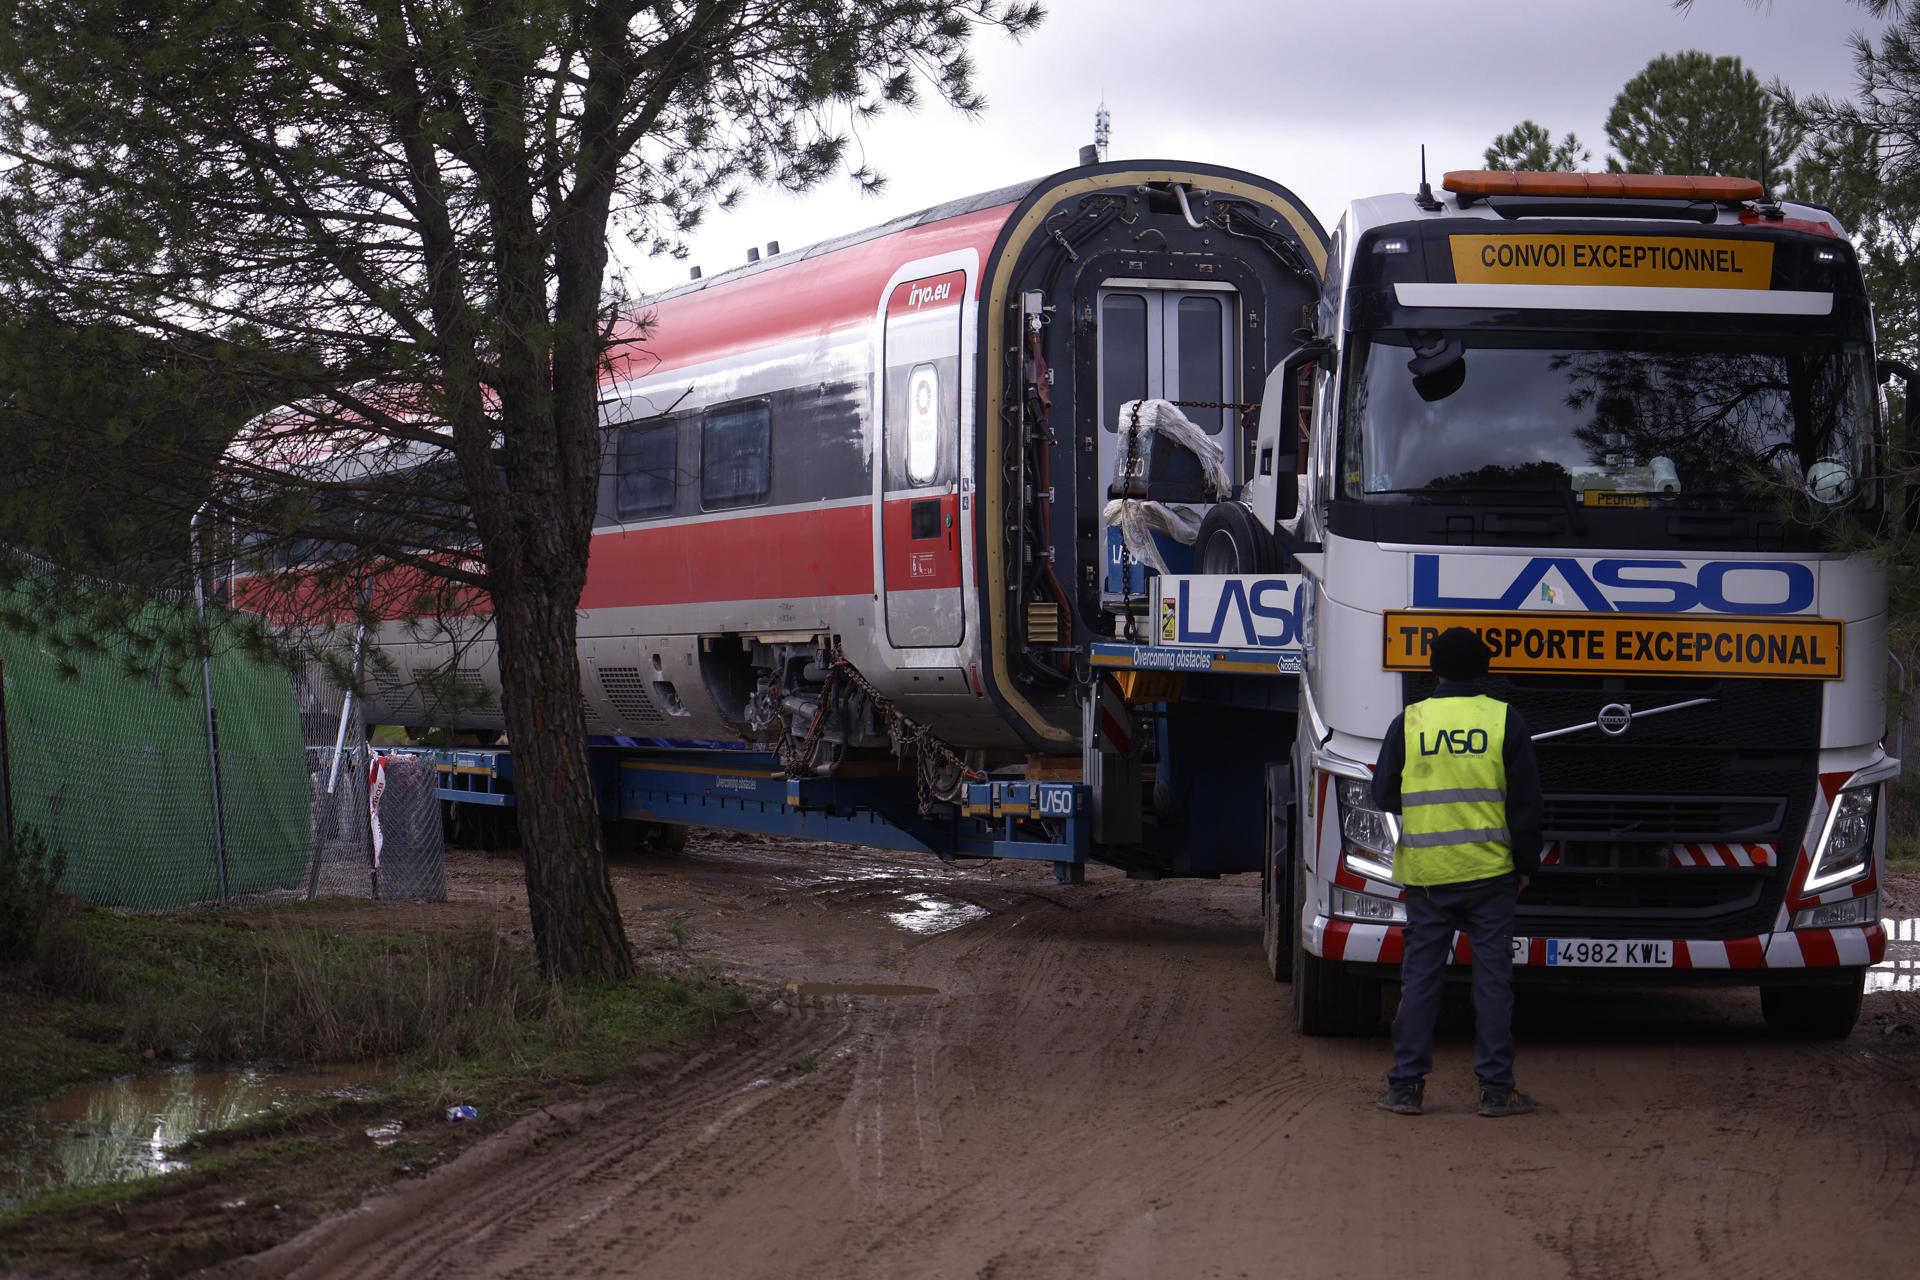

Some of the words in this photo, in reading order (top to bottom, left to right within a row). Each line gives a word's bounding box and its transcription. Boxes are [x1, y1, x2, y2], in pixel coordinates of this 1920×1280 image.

[1481, 244, 1565, 268] CONVOI
[1573, 244, 1743, 273] EXCEPTIONNEL
[908, 283, 951, 311] iryo.eu
[1413, 554, 1815, 614] LASO
[1178, 579, 1302, 646] LAS
[1133, 648, 1175, 671] Overcoming
[1176, 649, 1211, 669] obstacles
[1400, 626, 1605, 660] TRSPORTE
[1616, 630, 1826, 665] EXCEPCIONAL
[1600, 716, 1629, 724] VOLVO
[1419, 728, 1488, 756] LASO
[1040, 790, 1072, 814] LASO
[1562, 942, 1618, 963] 4982
[1626, 943, 1667, 964] KWL
